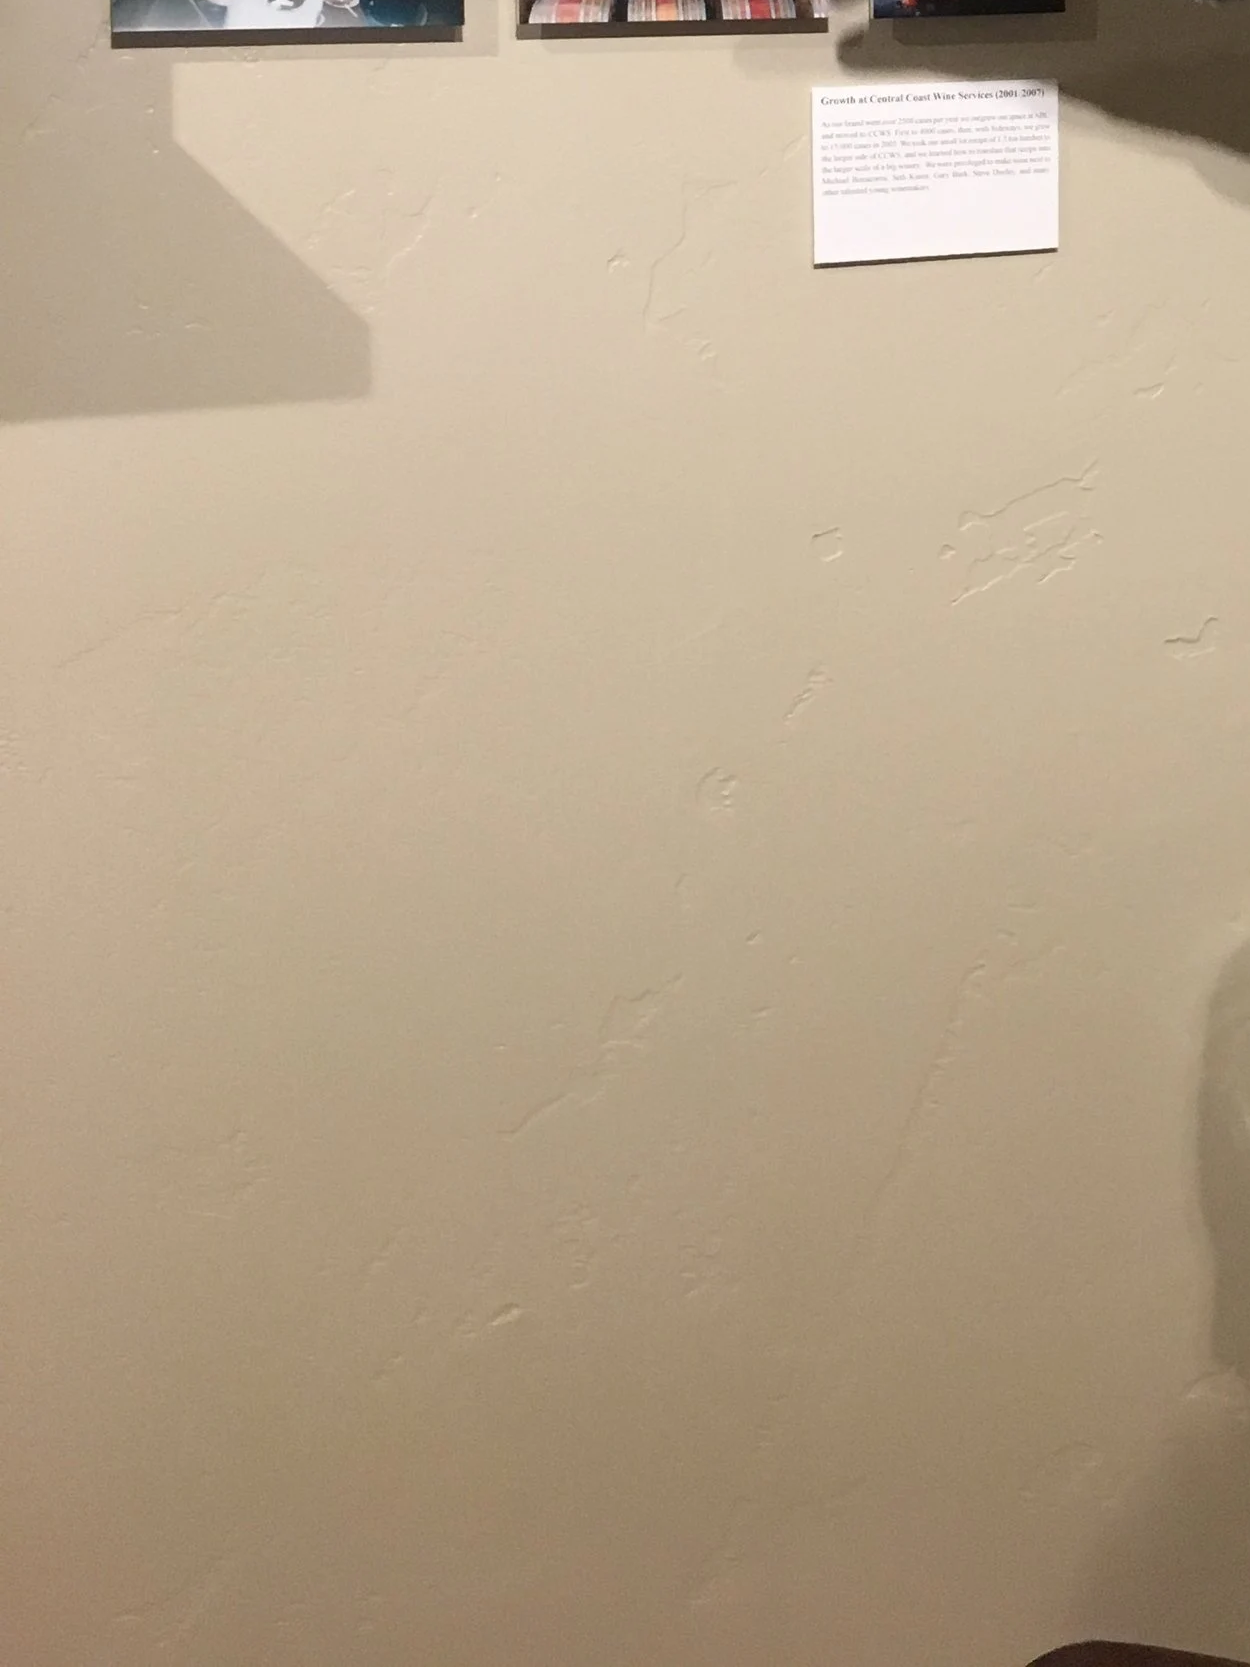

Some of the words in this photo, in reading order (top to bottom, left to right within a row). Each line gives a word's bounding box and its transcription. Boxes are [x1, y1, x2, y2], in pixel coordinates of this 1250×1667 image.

[820, 95, 856, 106] Growth
[858, 95, 868, 104] at
[869, 93, 904, 104] Central
[905, 92, 931, 102] Coast
[932, 91, 956, 101] Wine
[957, 89, 993, 100] Services
